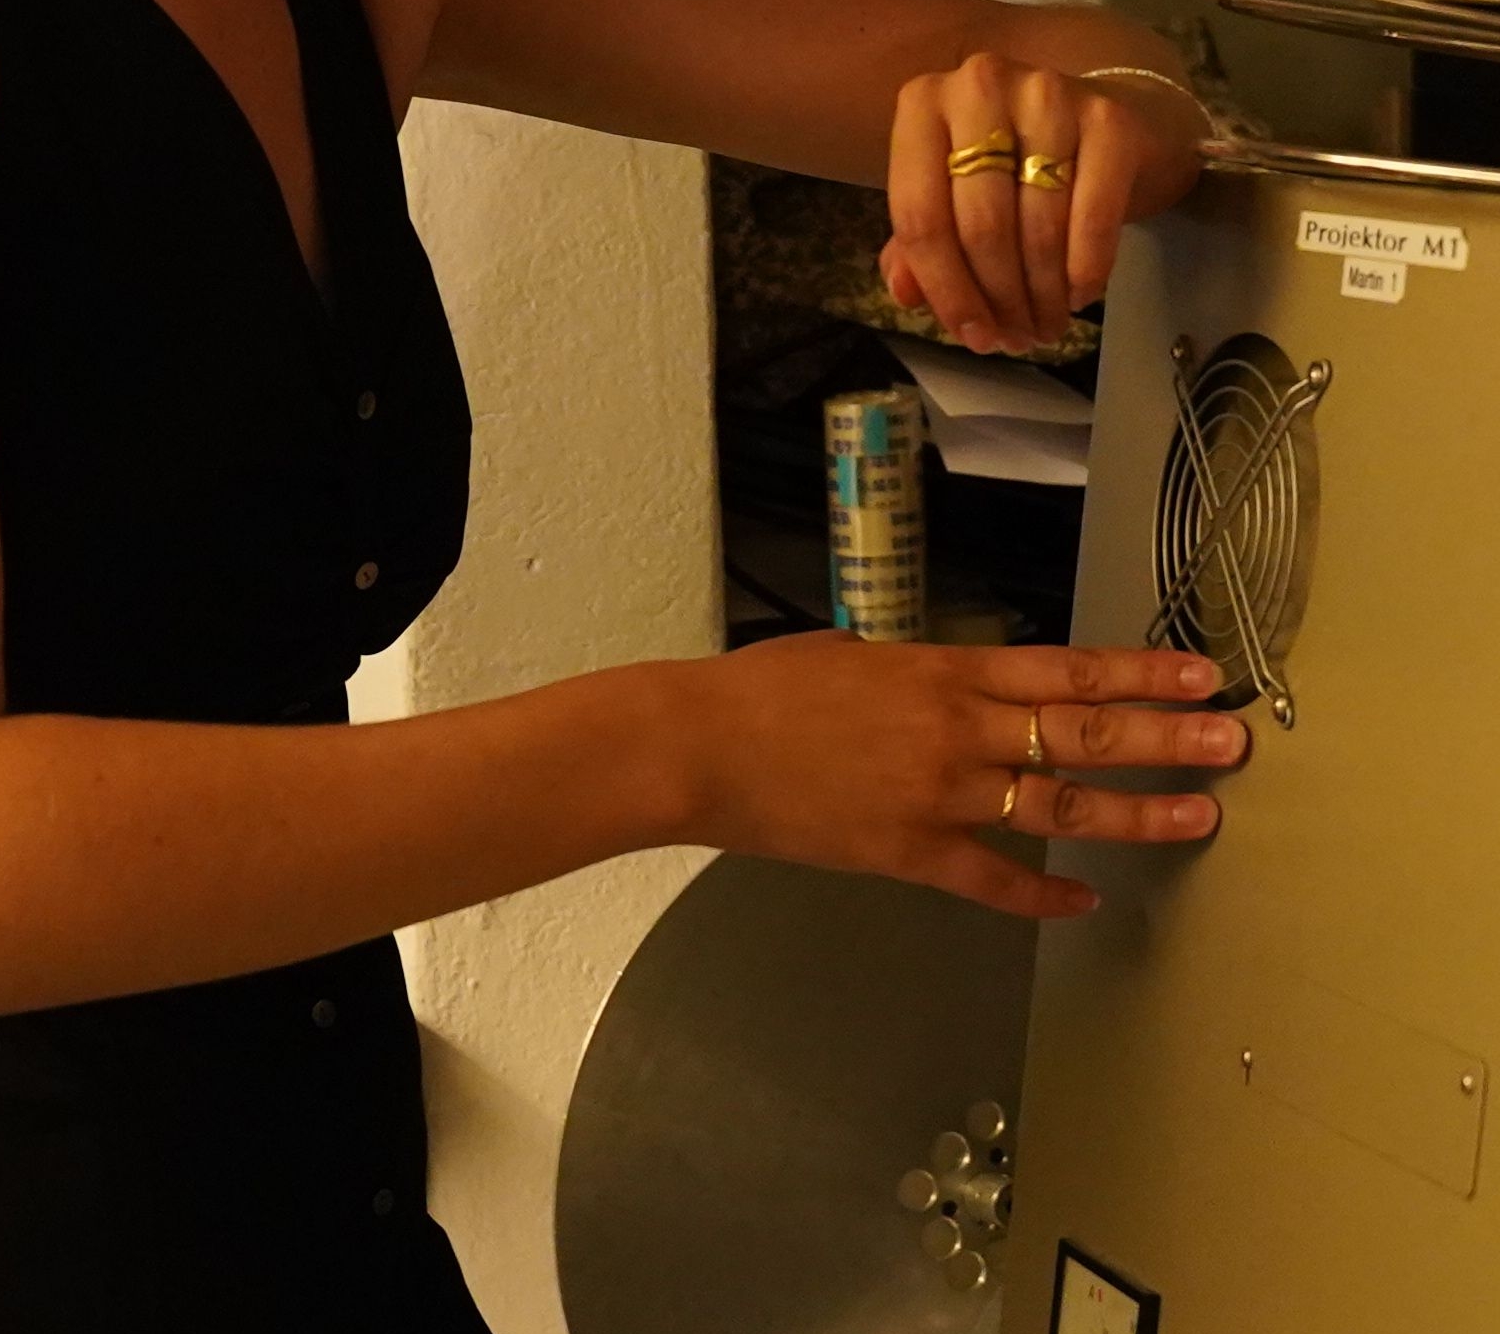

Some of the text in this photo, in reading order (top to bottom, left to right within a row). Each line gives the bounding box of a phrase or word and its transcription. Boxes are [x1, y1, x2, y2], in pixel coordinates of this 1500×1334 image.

[1305, 220, 1459, 259] Projektor M1
[1349, 267, 1385, 292] Martin
